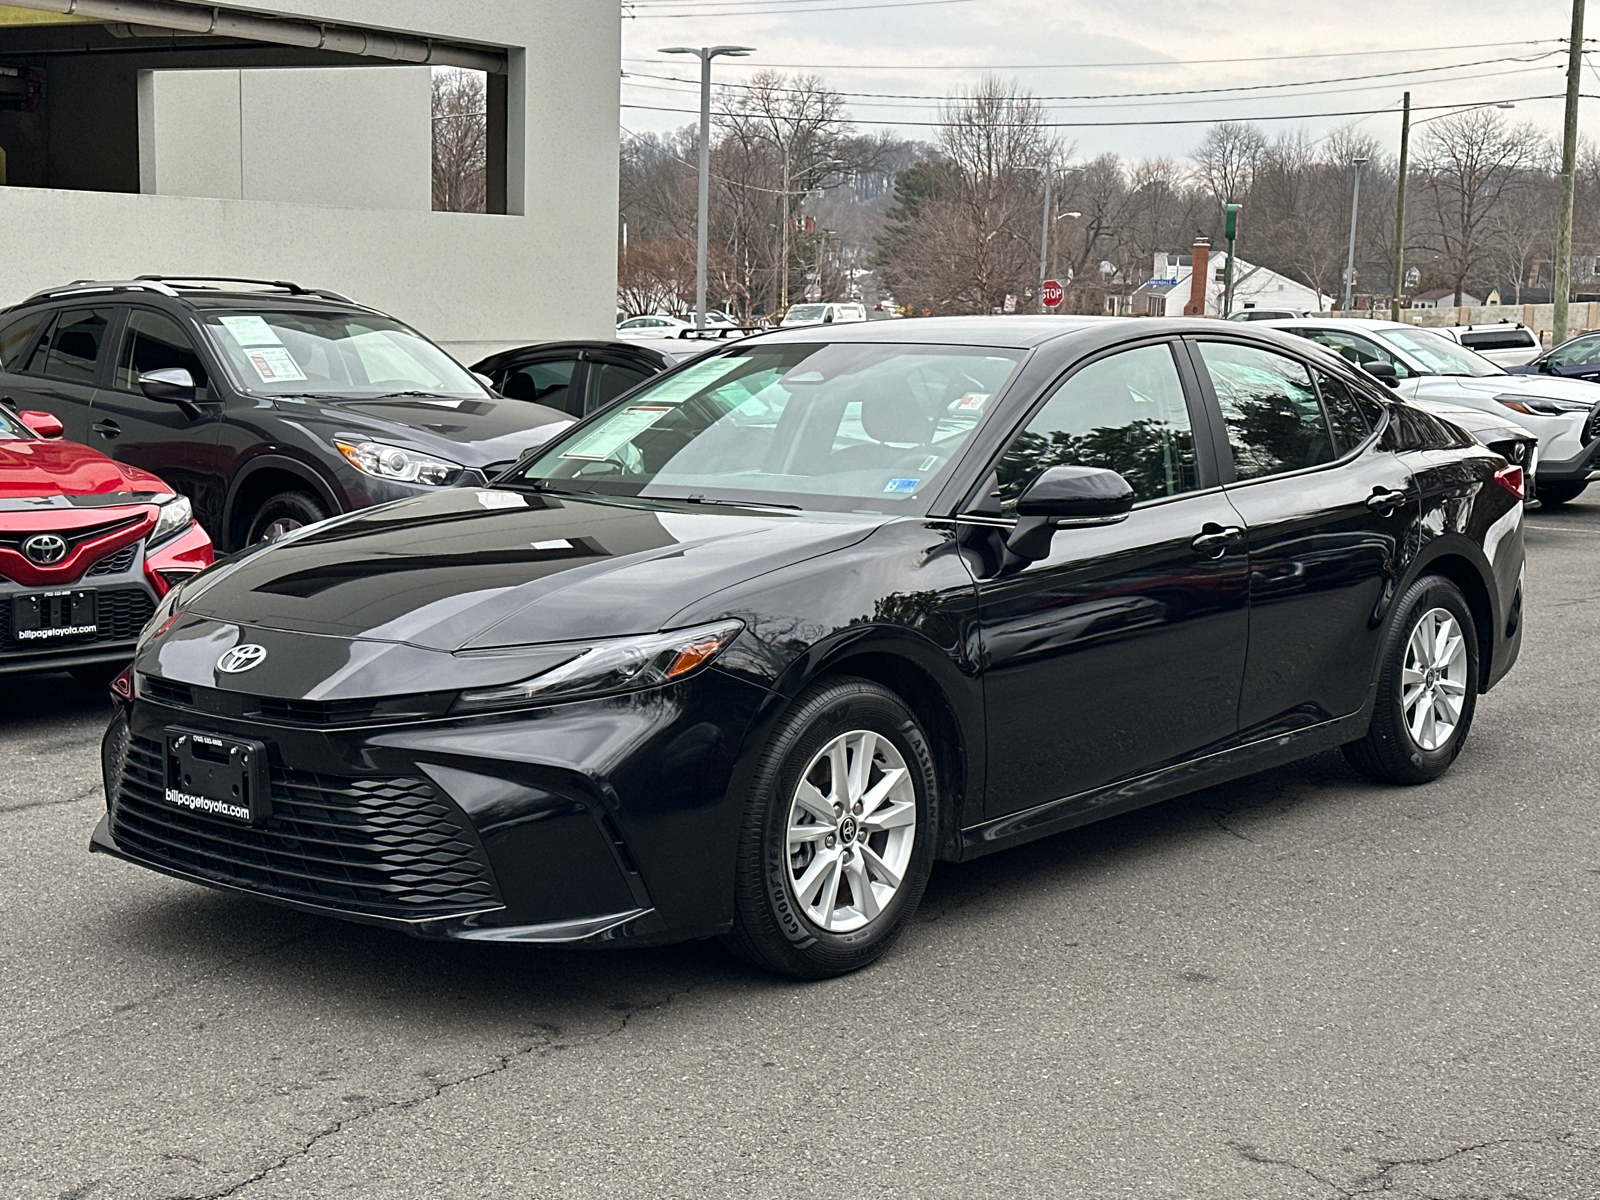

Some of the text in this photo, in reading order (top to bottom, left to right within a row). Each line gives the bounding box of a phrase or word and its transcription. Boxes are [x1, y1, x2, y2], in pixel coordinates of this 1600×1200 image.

[1042, 288, 1062, 300] STOP
[18, 624, 97, 640] billpagetoyota.com
[165, 788, 250, 819] billpagetoyota.com
